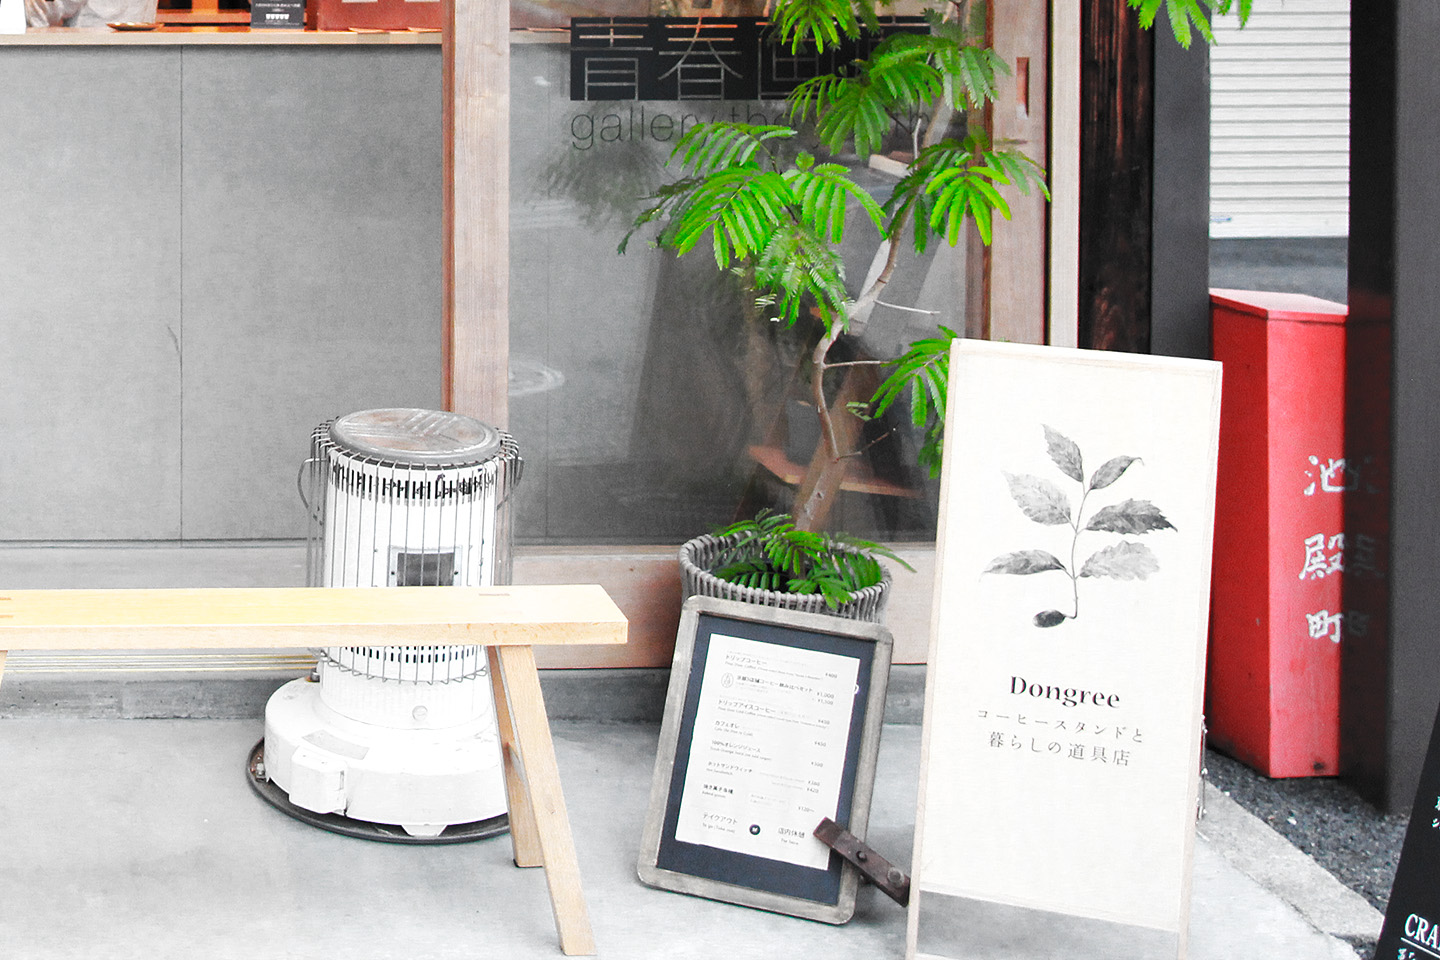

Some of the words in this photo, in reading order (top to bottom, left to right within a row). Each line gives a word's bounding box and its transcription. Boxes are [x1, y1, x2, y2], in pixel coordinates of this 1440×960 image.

[1010, 676, 1120, 708] Dongree
[978, 710, 1143, 743] コーヒースタンドと
[989, 731, 1131, 767] 暮らしの道具店
[1405, 913, 1440, 951] CRA
